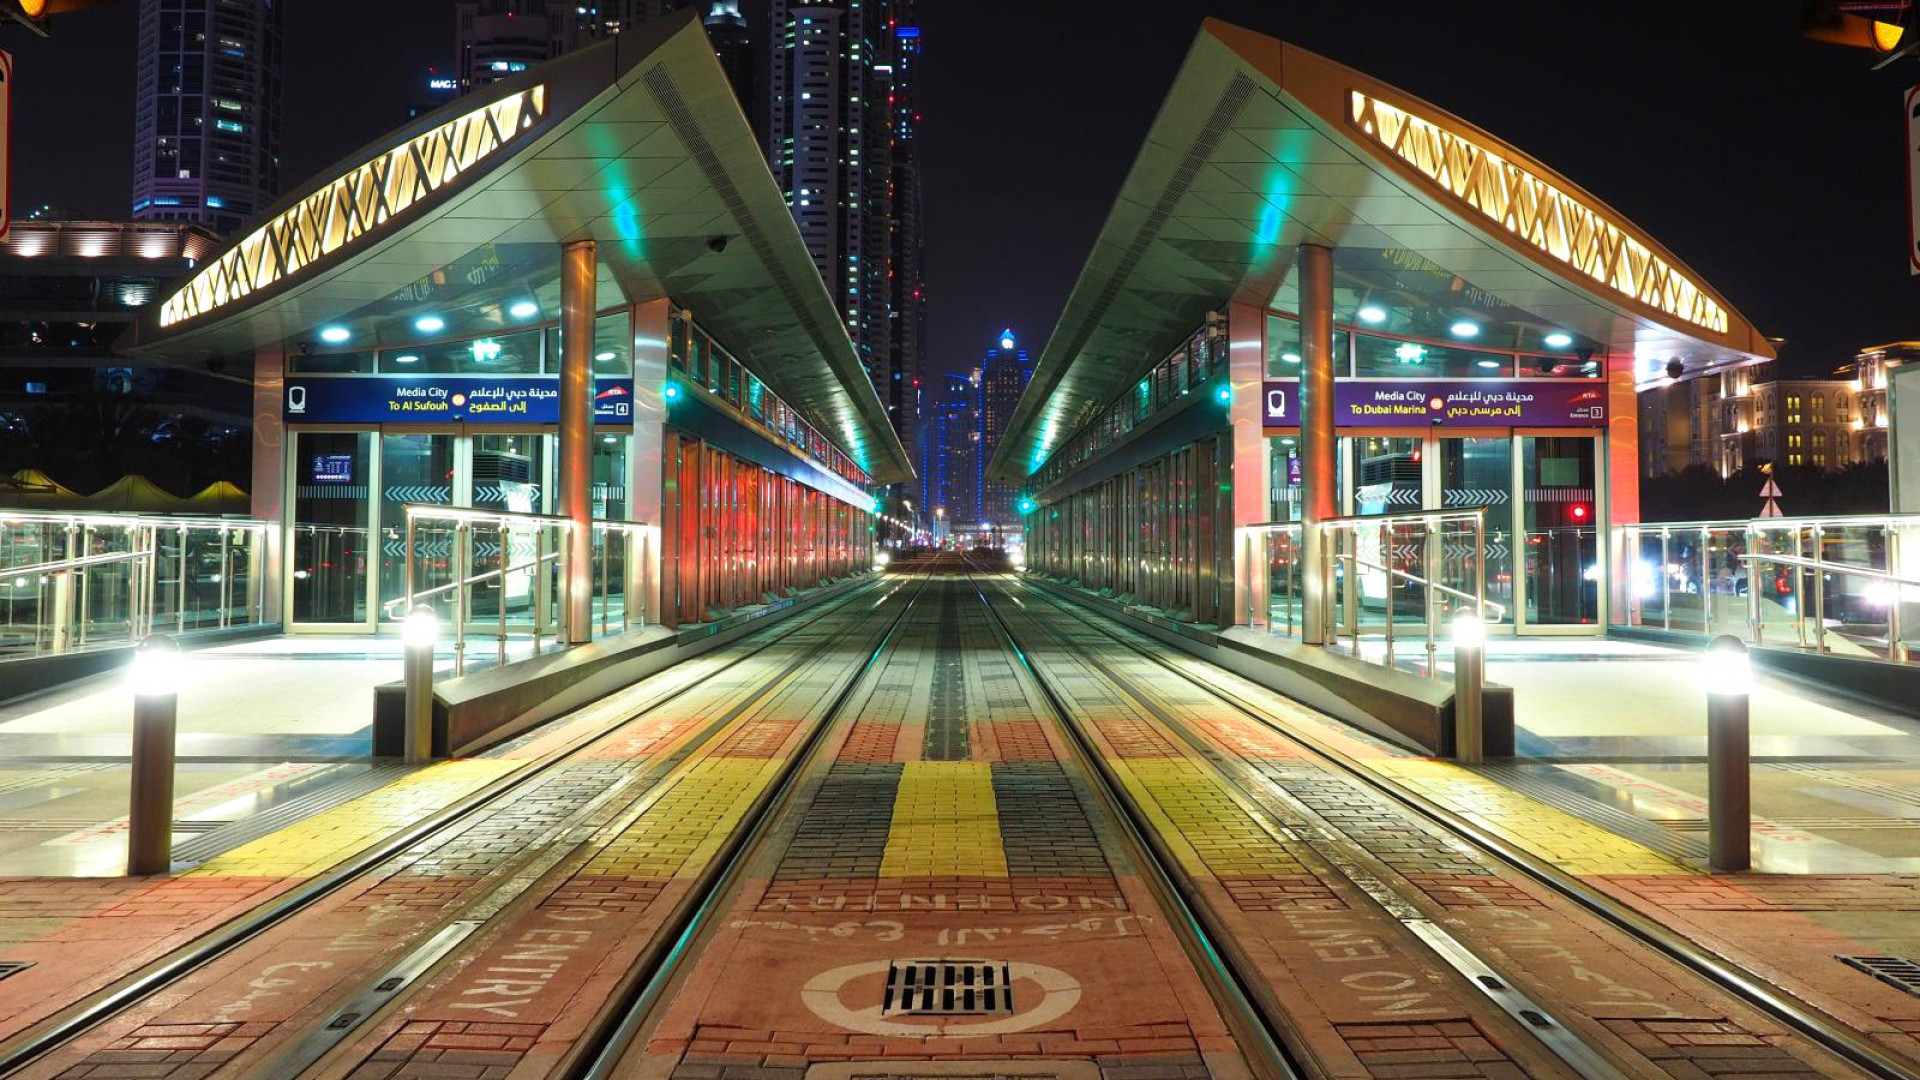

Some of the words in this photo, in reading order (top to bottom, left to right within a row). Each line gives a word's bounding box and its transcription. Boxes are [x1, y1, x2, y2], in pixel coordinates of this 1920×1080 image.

[431, 80, 451, 88] MAG
[396, 387, 427, 397] Media
[428, 387, 449, 400] City
[469, 387, 504, 400] للإعلام
[505, 389, 527, 401] دبي
[528, 388, 558, 400] مدينة
[1375, 390, 1405, 401] Media
[1406, 390, 1426, 403] City
[1447, 391, 1481, 403] للإعلام
[1483, 393, 1504, 405] دبي
[1505, 392, 1534, 403] مدينة
[389, 400, 400, 411] To
[402, 400, 413, 411] Al
[414, 400, 448, 411] Sufouh
[469, 400, 506, 413] الصفوح
[508, 400, 527, 413] إلى
[1350, 404, 1363, 414] To
[1364, 404, 1392, 414] Dubai
[1393, 404, 1427, 414] Marina
[1469, 406, 1502, 417] مرسى
[1503, 404, 1521, 417] إلى
[1447, 406, 1468, 418] دبي
[757, 894, 992, 911] ENTRY
[1020, 894, 1131, 911] NO
[448, 929, 593, 1017] ENTRY
[1341, 970, 1449, 1016] NO
